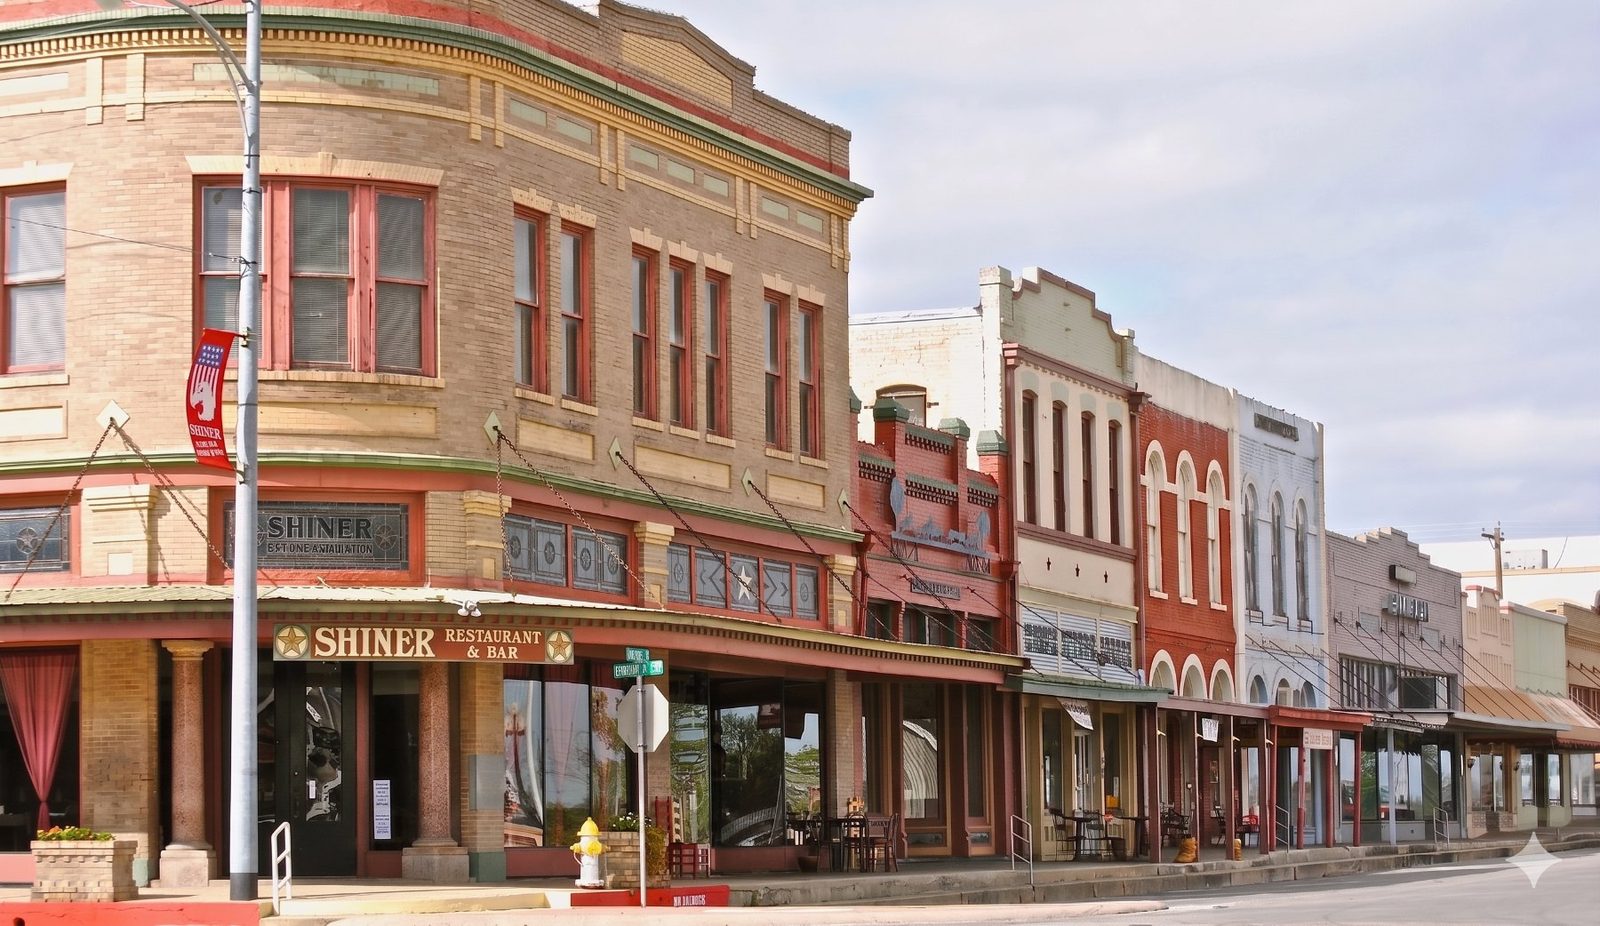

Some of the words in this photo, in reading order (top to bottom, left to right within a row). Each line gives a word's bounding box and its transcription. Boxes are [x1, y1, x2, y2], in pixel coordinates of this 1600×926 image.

[190, 424, 221, 440] SHINER
[267, 516, 372, 539] SHINER
[314, 627, 435, 657] SHINER
[445, 629, 541, 645] RESTAURANT
[467, 645, 480, 658] &
[487, 645, 518, 659] BAR
